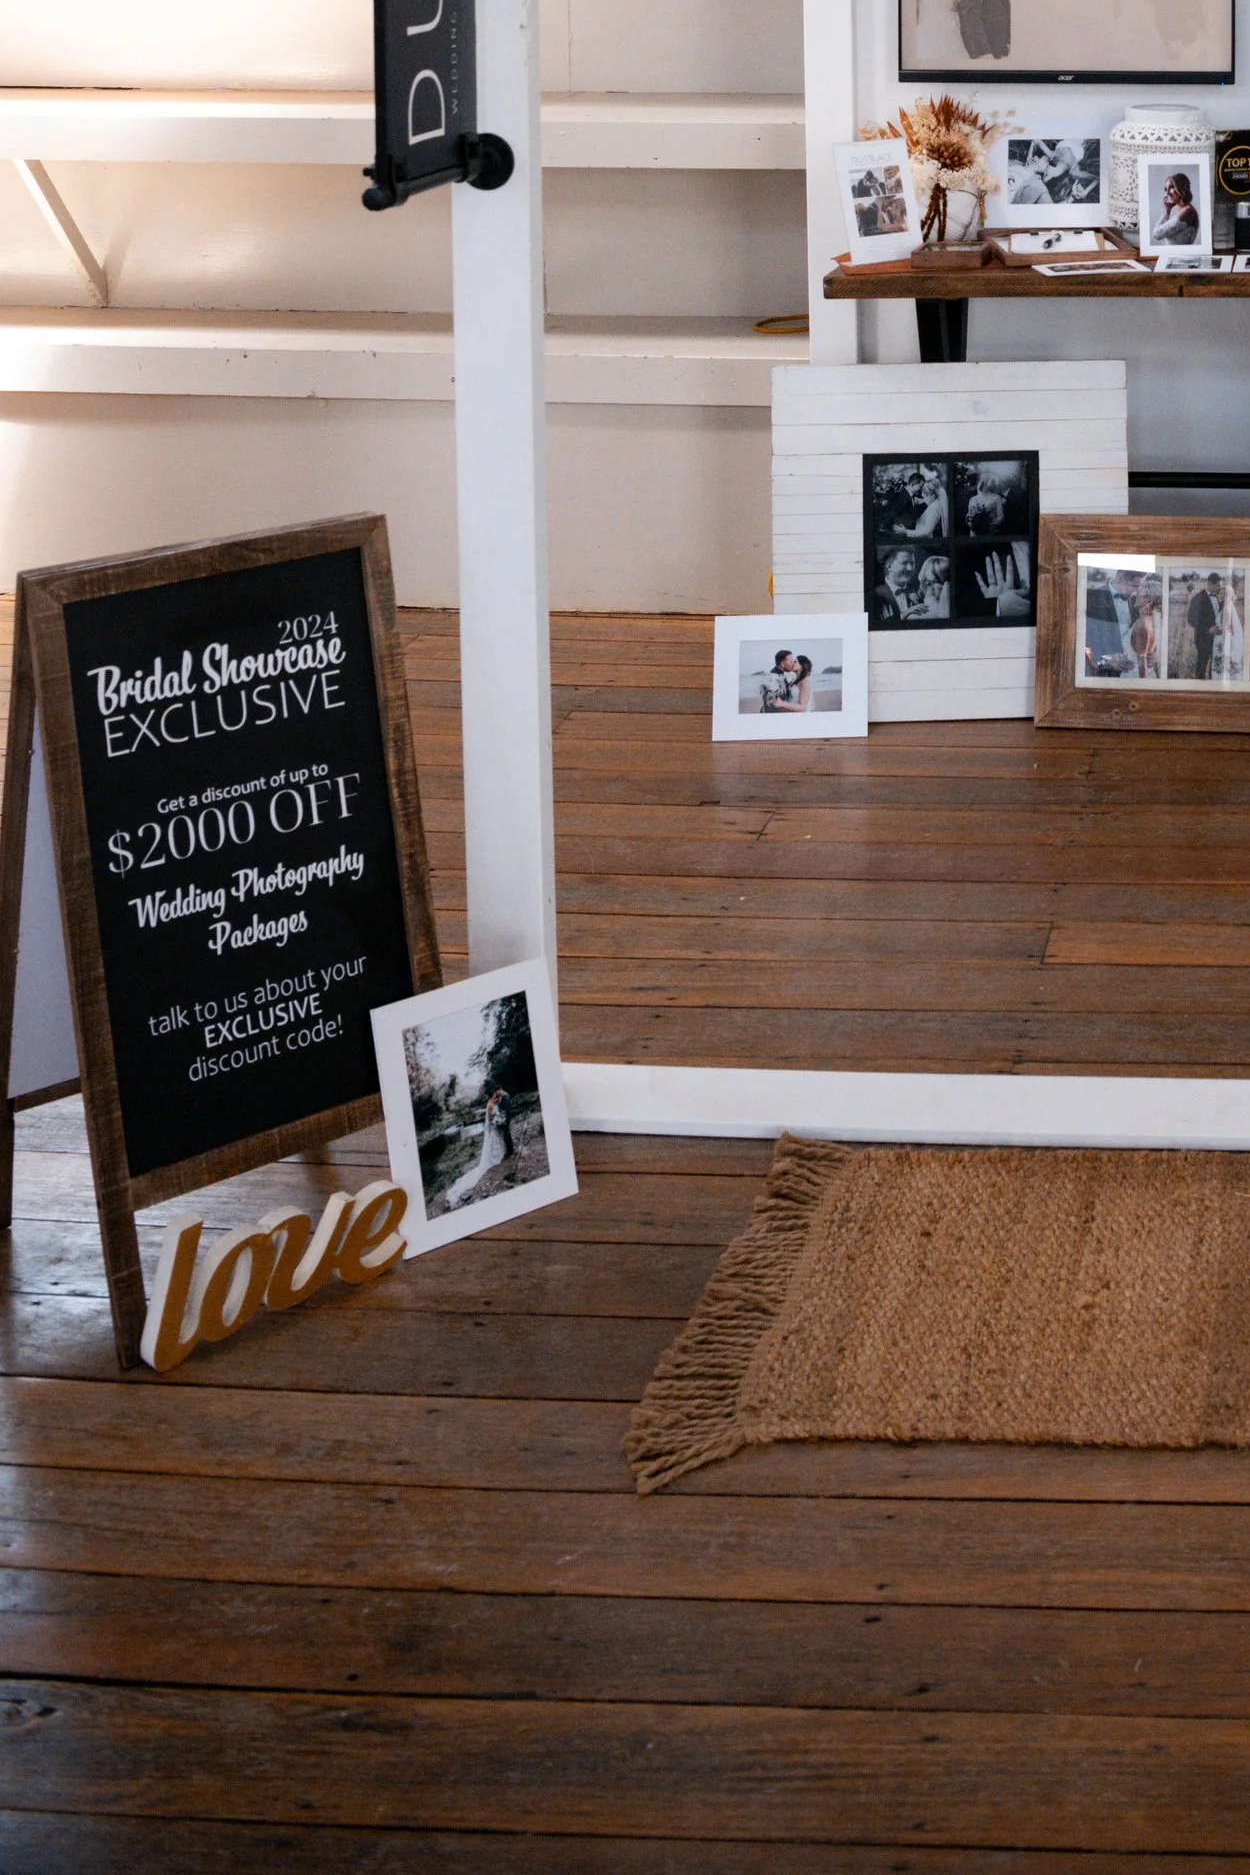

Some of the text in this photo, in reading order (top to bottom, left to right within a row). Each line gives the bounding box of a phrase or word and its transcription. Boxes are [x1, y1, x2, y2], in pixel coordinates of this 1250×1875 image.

[1226, 158, 1246, 168] TOP
[278, 611, 338, 645] 2024
[87, 637, 346, 716] Bridal Showcase
[104, 670, 346, 758] EXCLUSIVE
[157, 763, 329, 814] Get a discount of up to
[108, 772, 360, 879] $2000 OFF
[128, 844, 364, 928] Wedding Photography
[208, 910, 308, 955] Packages
[148, 956, 367, 1036] talk to us about your
[204, 992, 322, 1048] EXCLUSIVE
[188, 1014, 344, 1082] discount code!
[140, 1180, 408, 1373] love
